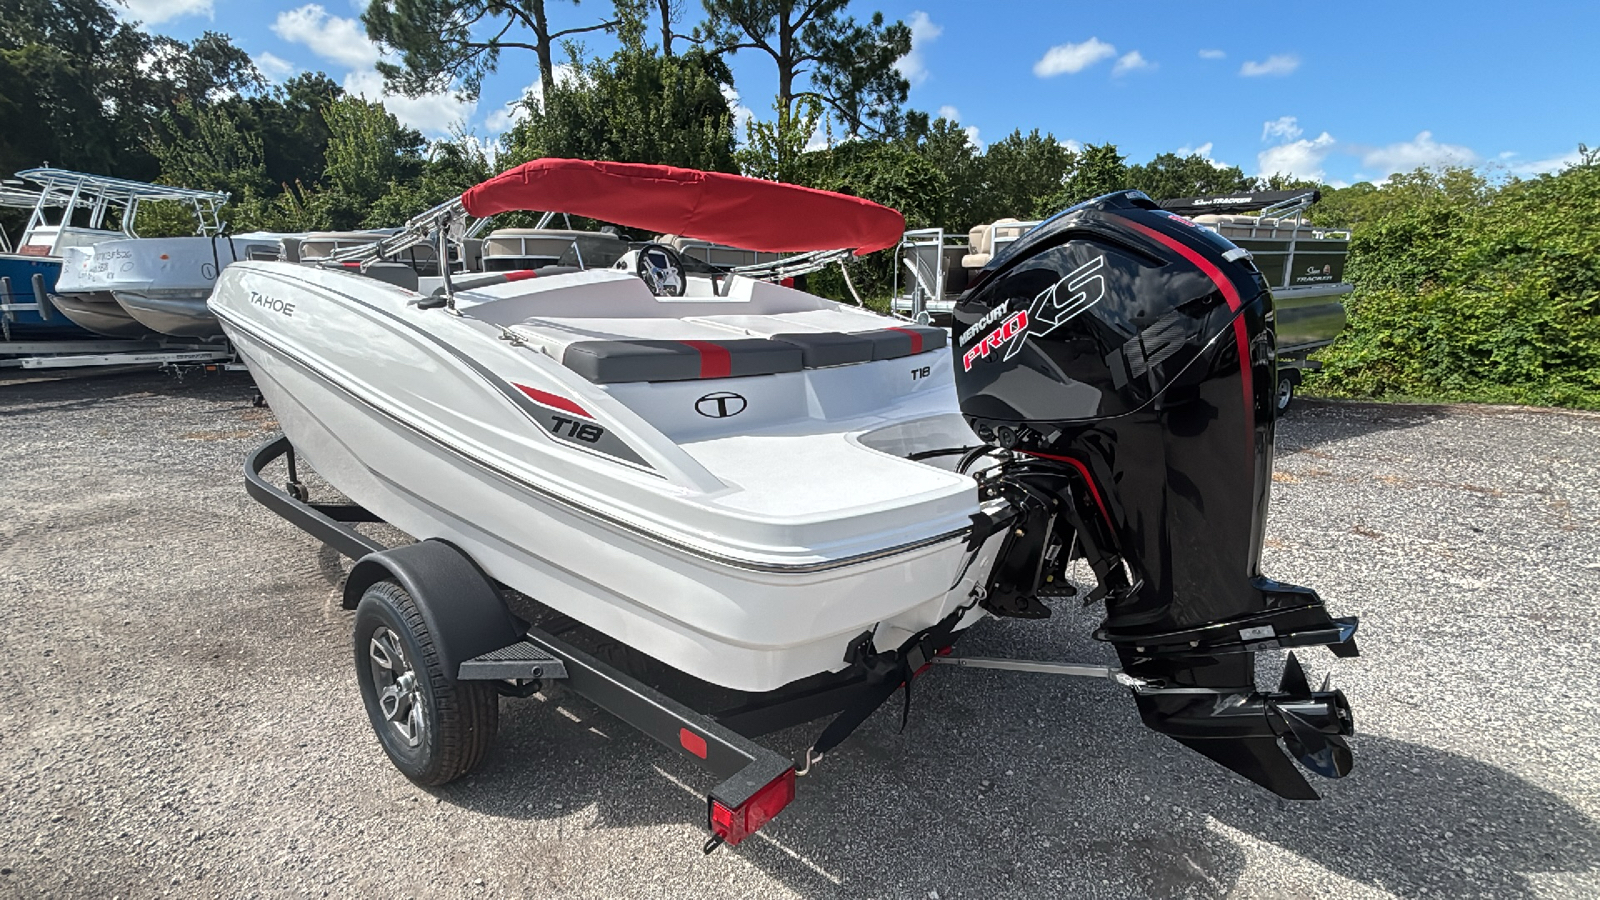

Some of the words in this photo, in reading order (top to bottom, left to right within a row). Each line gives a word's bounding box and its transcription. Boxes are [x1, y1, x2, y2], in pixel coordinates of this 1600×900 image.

[1213, 197, 1252, 205] TRACKER
[1296, 275, 1333, 283] TRACKER
[251, 291, 296, 317] TAHOE
[963, 309, 1029, 372] PRO
[1000, 254, 1105, 362] XS
[958, 298, 1010, 347] MERCURY
[911, 366, 931, 381] T18
[551, 415, 604, 444] T18
